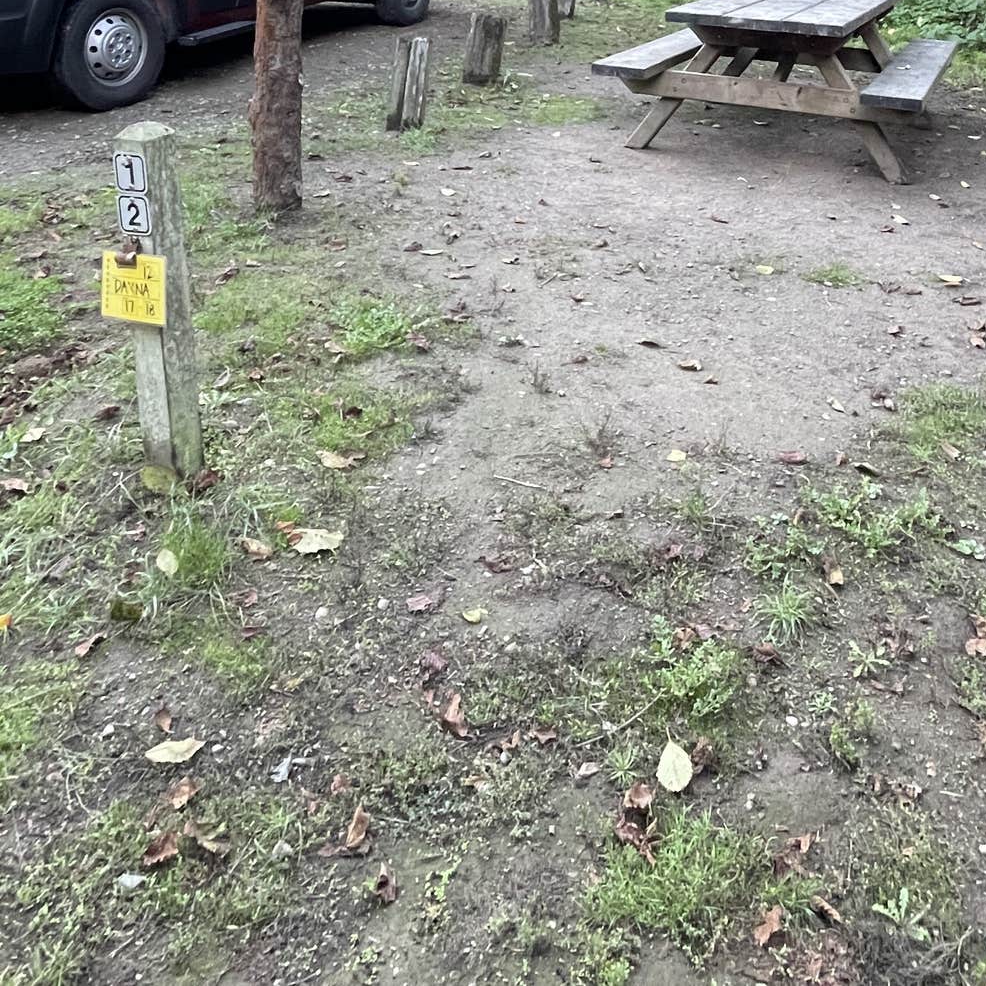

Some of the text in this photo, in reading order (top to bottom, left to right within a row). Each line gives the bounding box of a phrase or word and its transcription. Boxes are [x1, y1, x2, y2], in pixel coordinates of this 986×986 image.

[121, 157, 135, 185] 1
[127, 202, 142, 227] 2
[125, 299, 135, 313] 17
